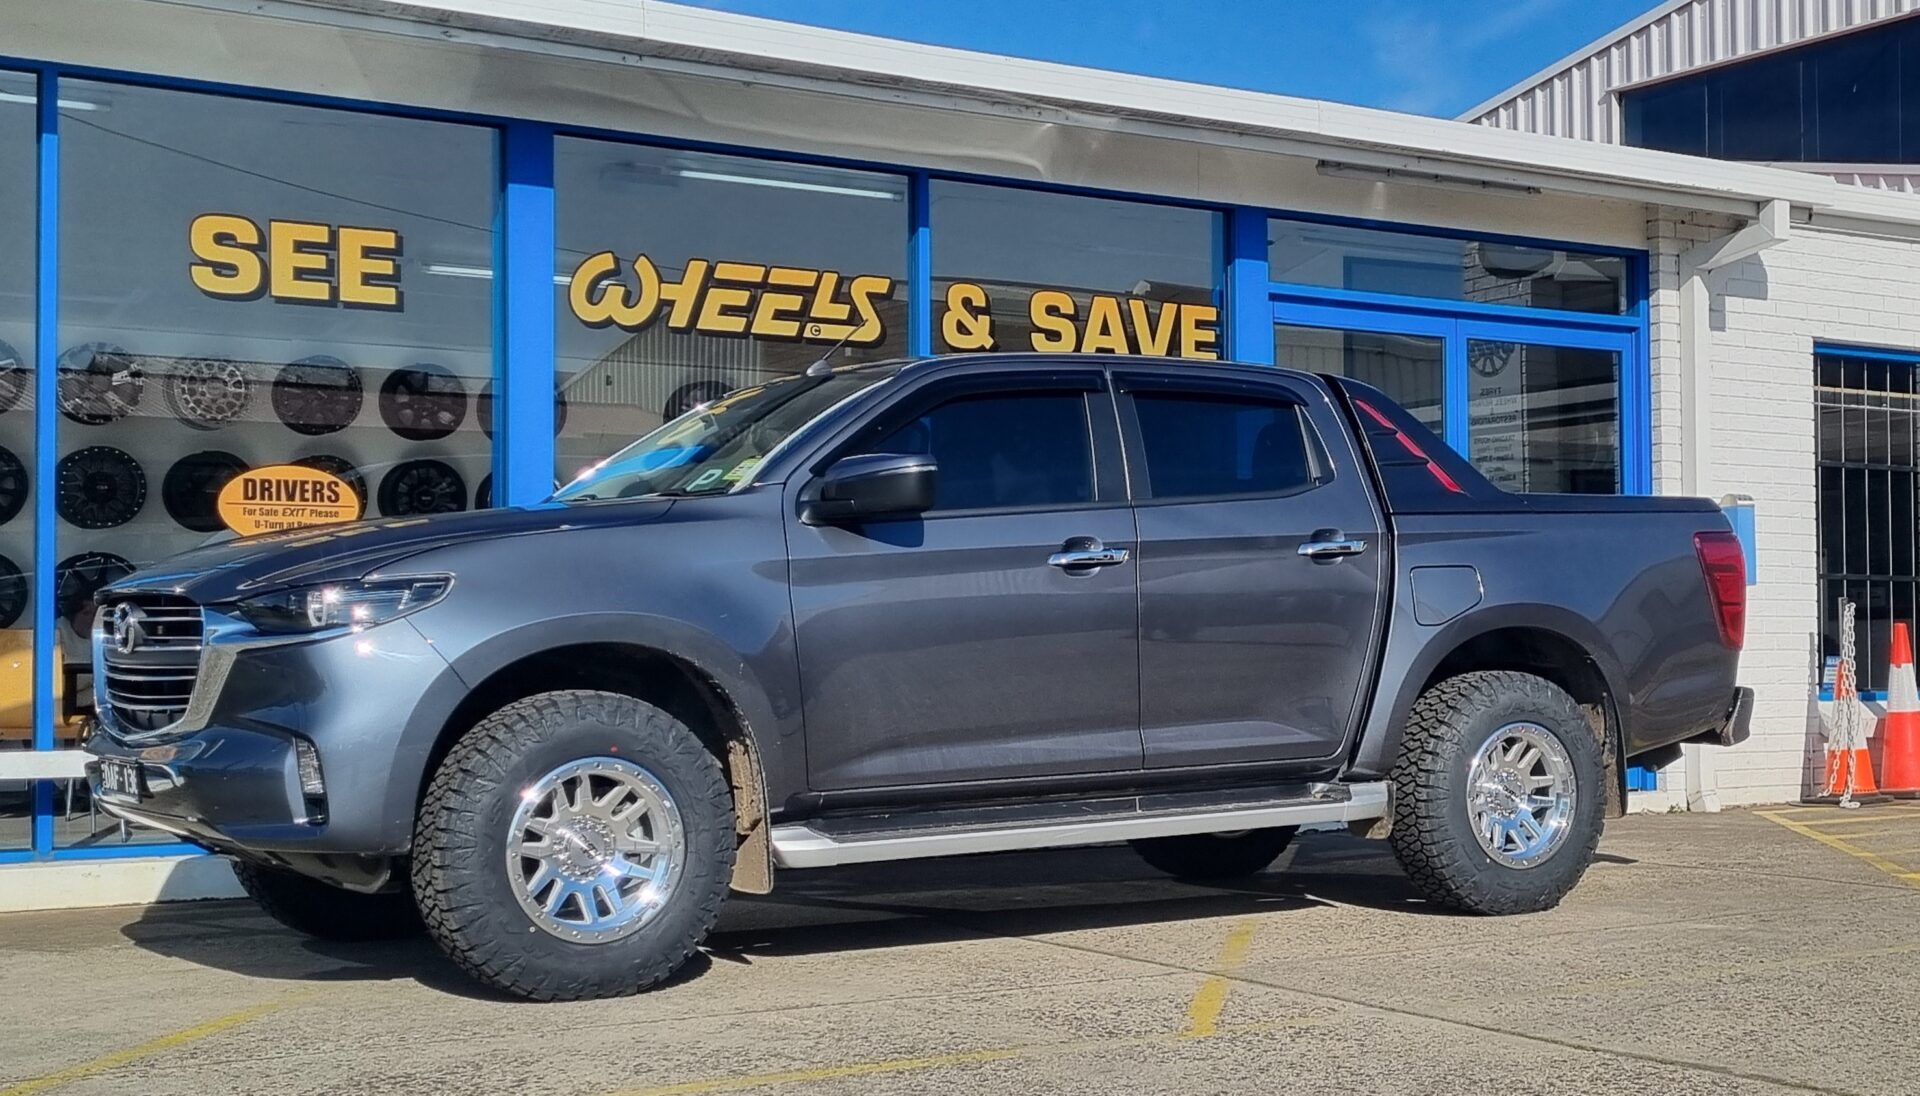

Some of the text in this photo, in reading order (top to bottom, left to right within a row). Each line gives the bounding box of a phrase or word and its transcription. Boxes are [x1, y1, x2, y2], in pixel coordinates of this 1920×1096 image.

[190, 213, 1219, 360] SEE WHEELS & SAVE
[242, 478, 340, 503] DRIVERS
[686, 469, 723, 492] P
[242, 507, 340, 519] For Sale EXIT Please
[254, 520, 284, 530] U-Turn
[286, 521, 295, 529] at
